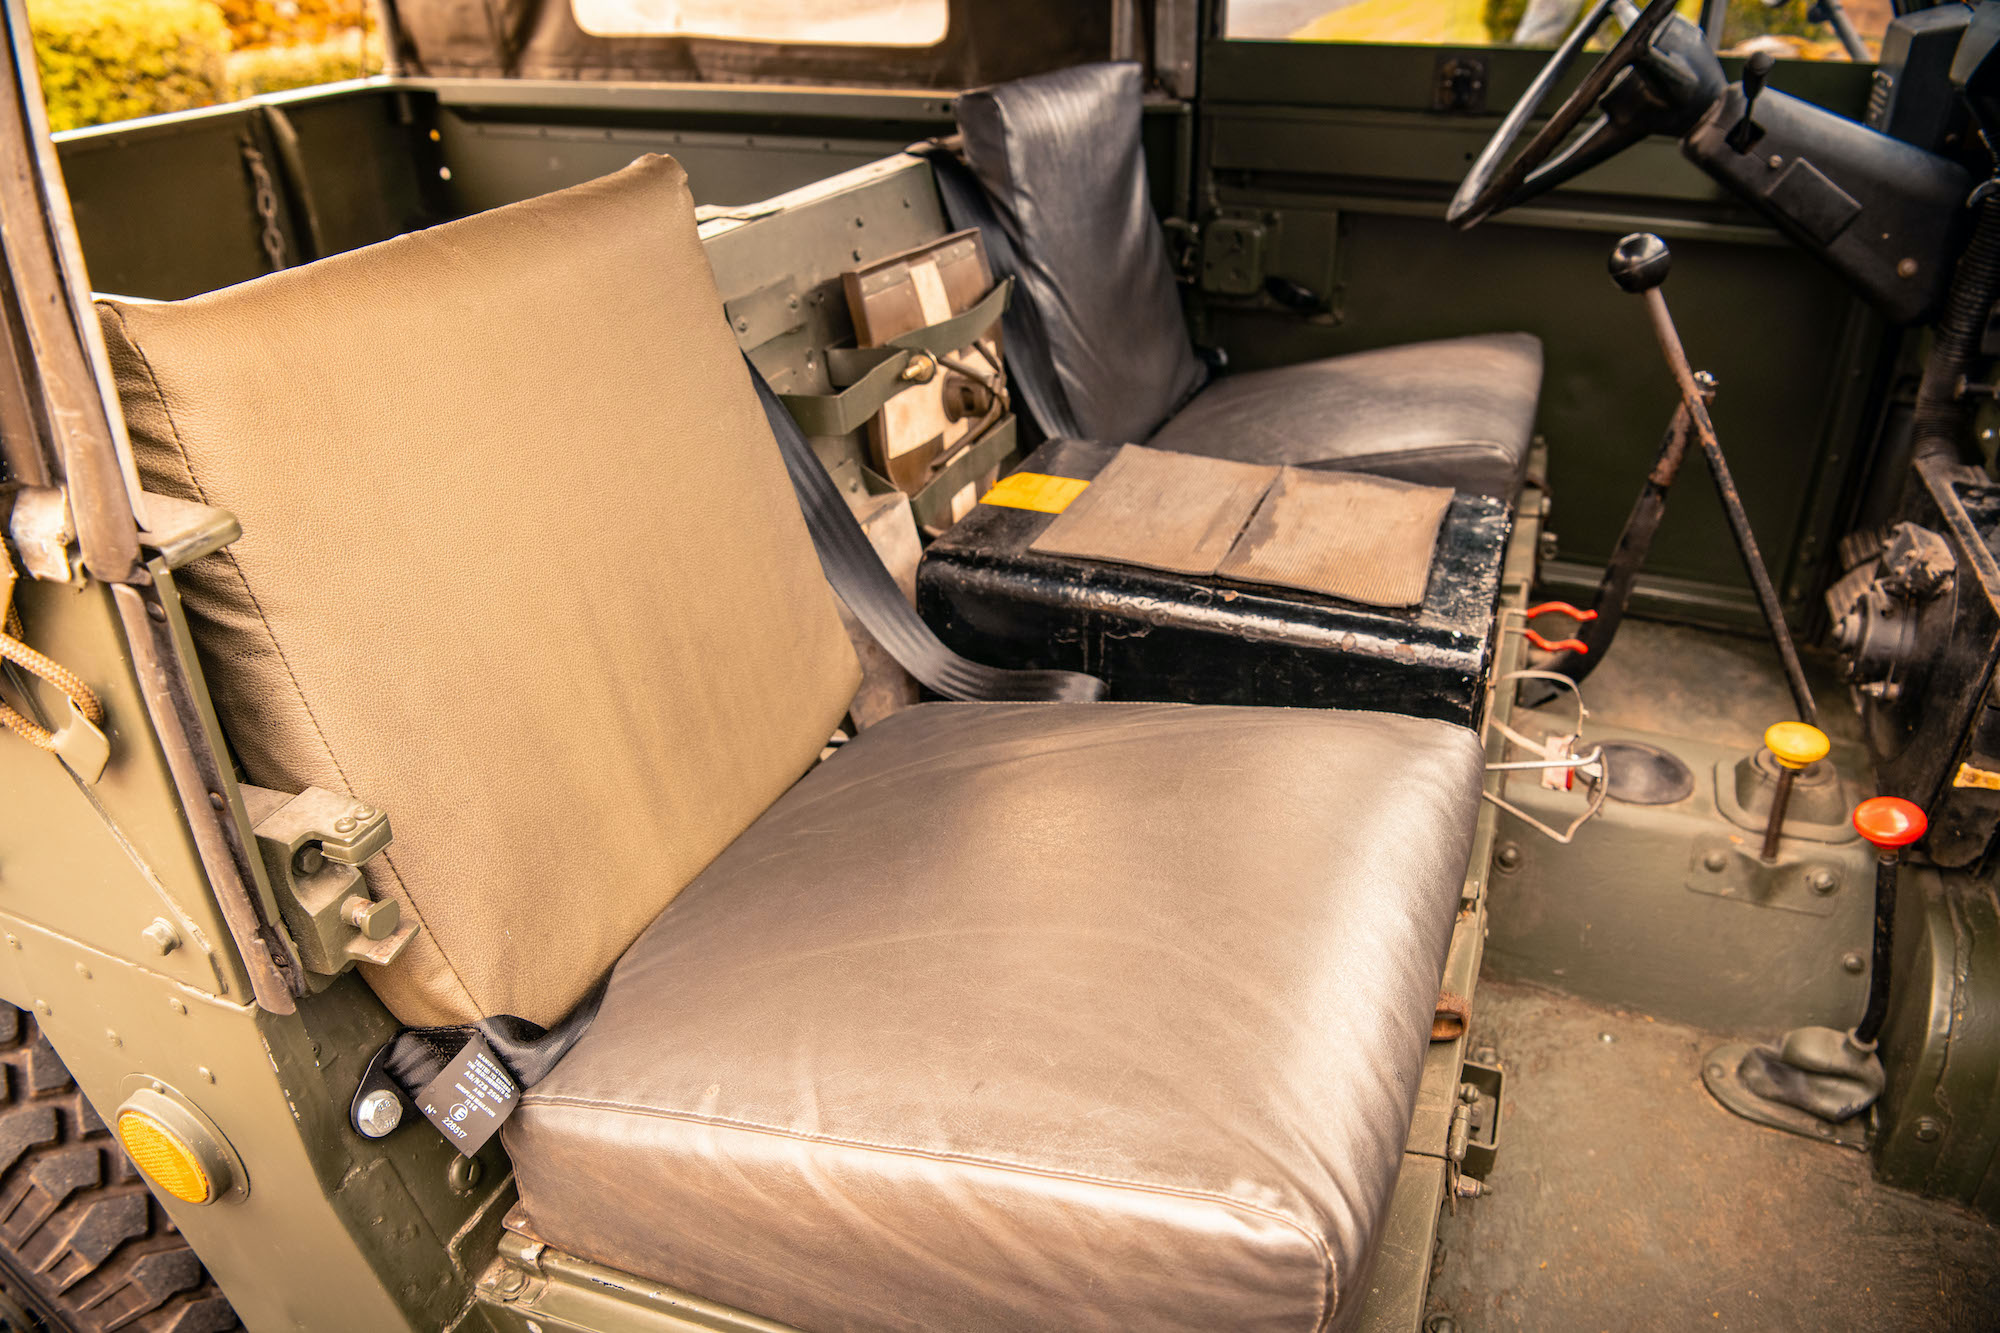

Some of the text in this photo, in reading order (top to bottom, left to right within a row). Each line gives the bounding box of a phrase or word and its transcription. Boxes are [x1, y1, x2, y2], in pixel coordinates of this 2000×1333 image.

[466, 1060, 511, 1100] THE REQUIREMENTS OF
[474, 1059, 511, 1094] TESTED TO EXCEED
[476, 1052, 511, 1087] MANUFACTURED
[463, 1070, 503, 1104] AS/NZS 2596
[472, 1087, 485, 1099] AND
[464, 1098, 479, 1112] R16
[441, 1116, 468, 1139] 228517
